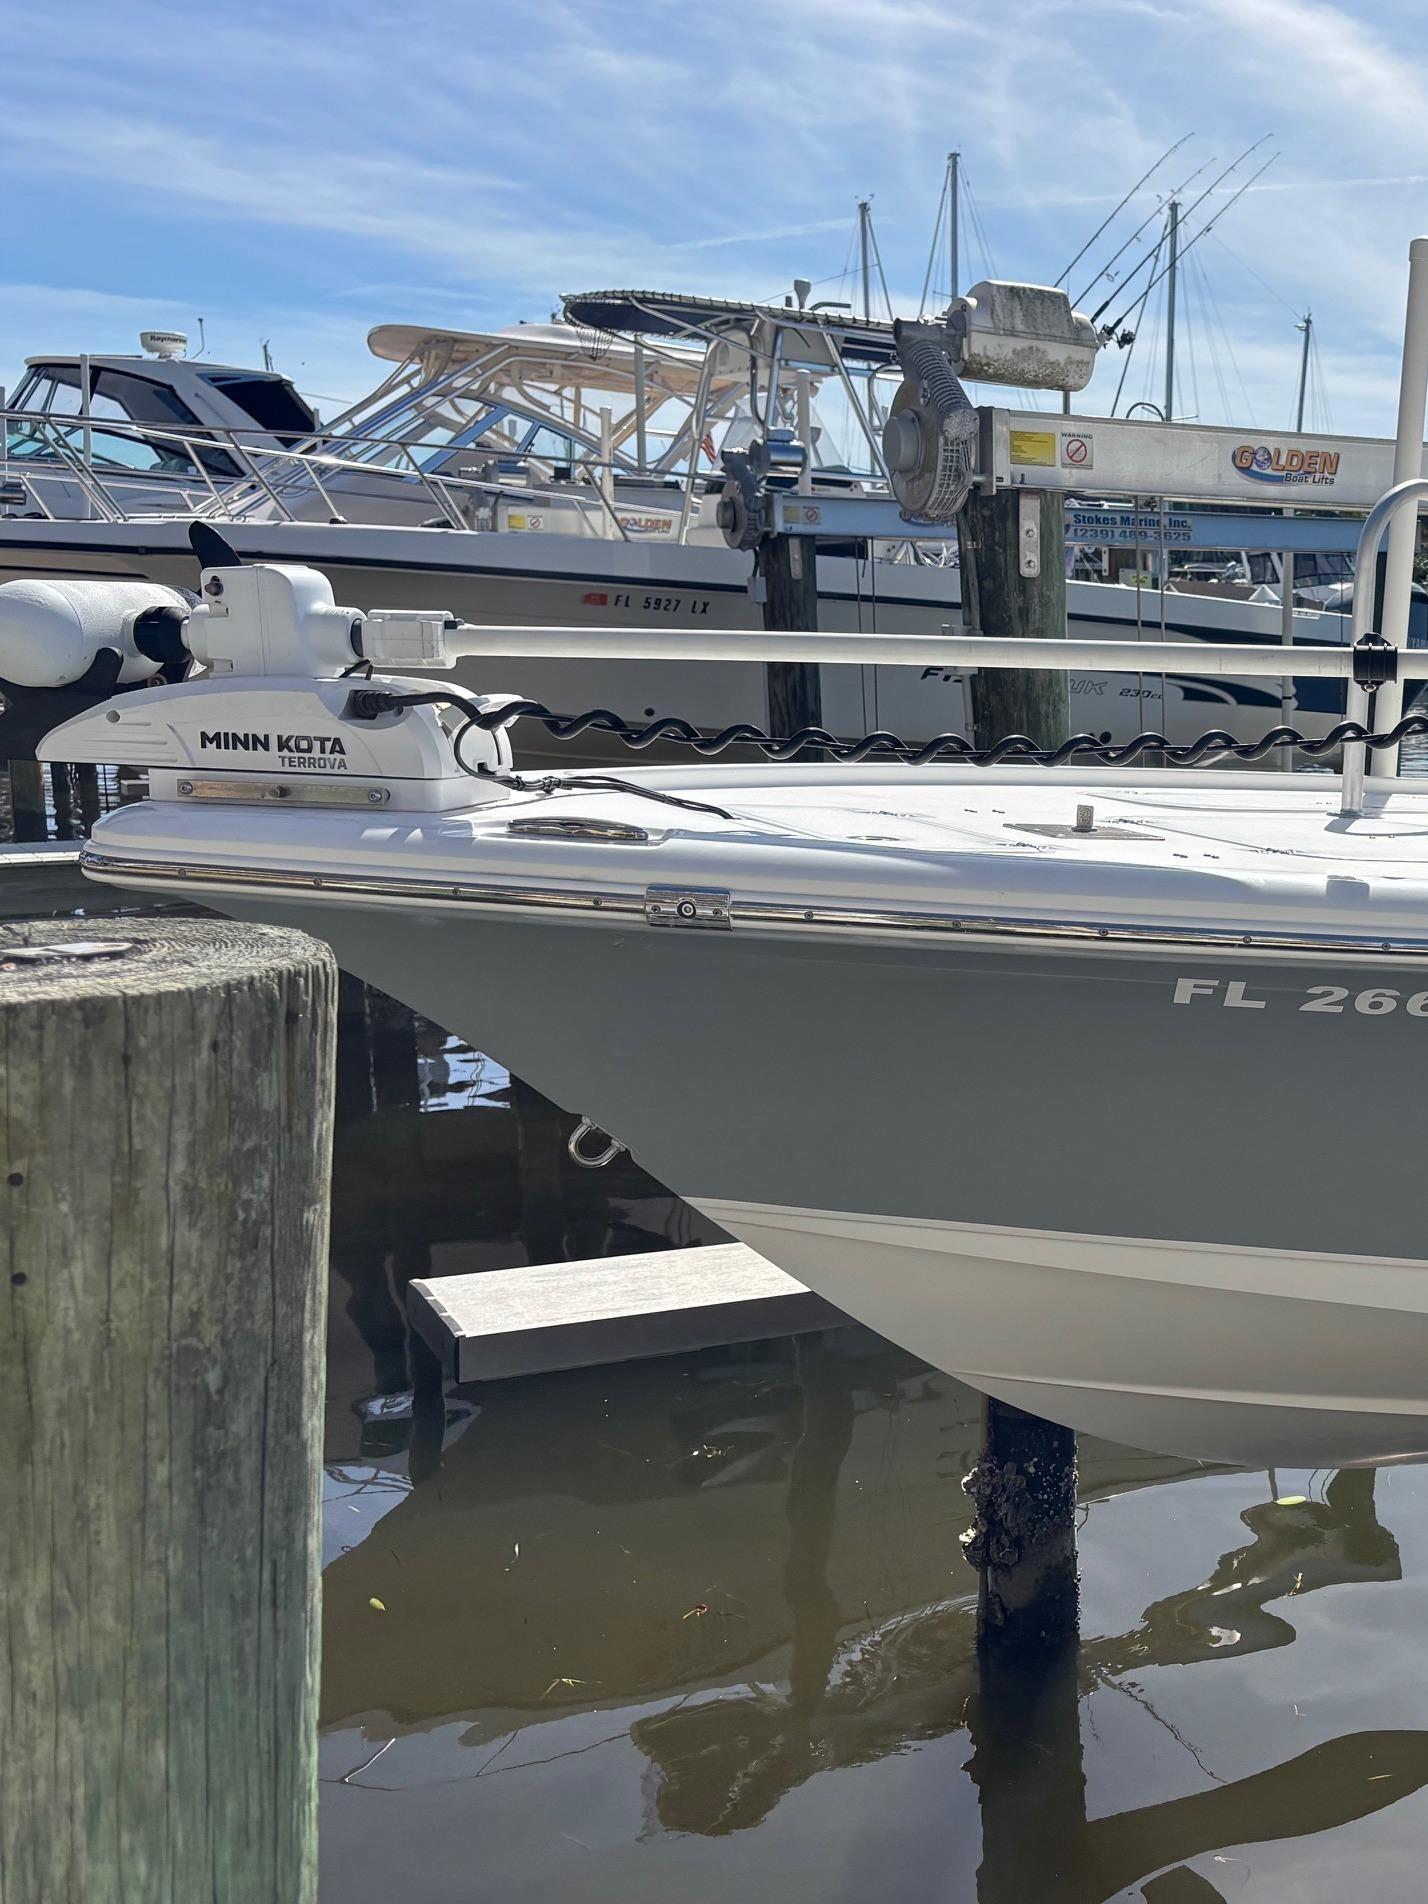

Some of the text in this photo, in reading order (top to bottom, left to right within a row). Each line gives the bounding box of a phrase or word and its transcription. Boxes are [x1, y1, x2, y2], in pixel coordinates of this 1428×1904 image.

[1234, 445, 1340, 475] GOLDEN
[1284, 473, 1335, 485] Boat Lifts
[1074, 514, 1117, 526] Stokes
[1169, 518, 1191, 528] Inc.
[1119, 530, 1191, 541] 489-3625
[614, 594, 630, 608] FL
[643, 596, 681, 612] 5927
[691, 601, 710, 614] LX
[200, 730, 346, 755] MINN KOTA
[278, 755, 348, 770] TERROVA
[1173, 978, 1267, 1009] FL
